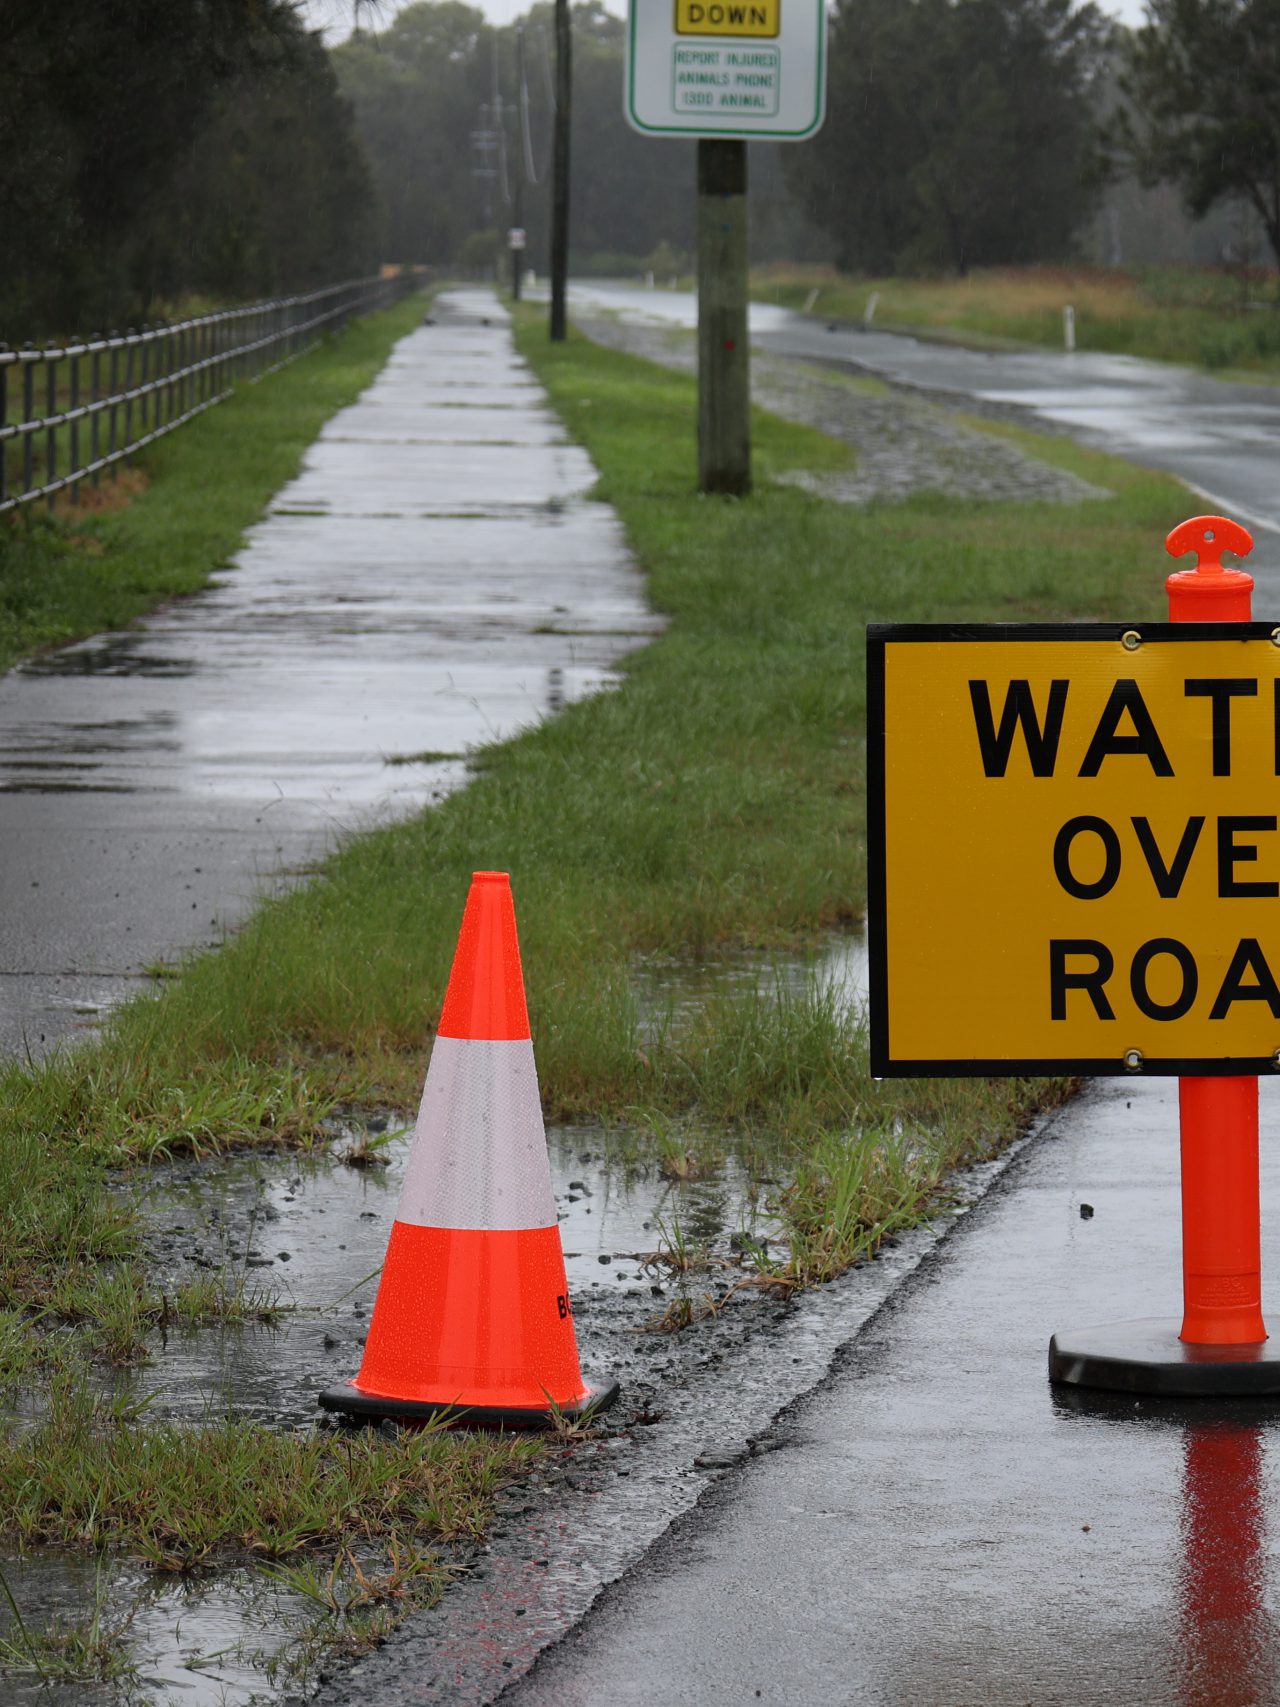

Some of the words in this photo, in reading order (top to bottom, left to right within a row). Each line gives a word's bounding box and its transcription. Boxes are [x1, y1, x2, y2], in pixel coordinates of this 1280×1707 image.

[688, 4, 767, 25] DOWN
[676, 51, 720, 65] REPORT
[727, 53, 777, 67] INJURED
[678, 72, 730, 86] ANIMALS
[735, 74, 774, 88] PHONE
[720, 93, 767, 107] ANIMAL
